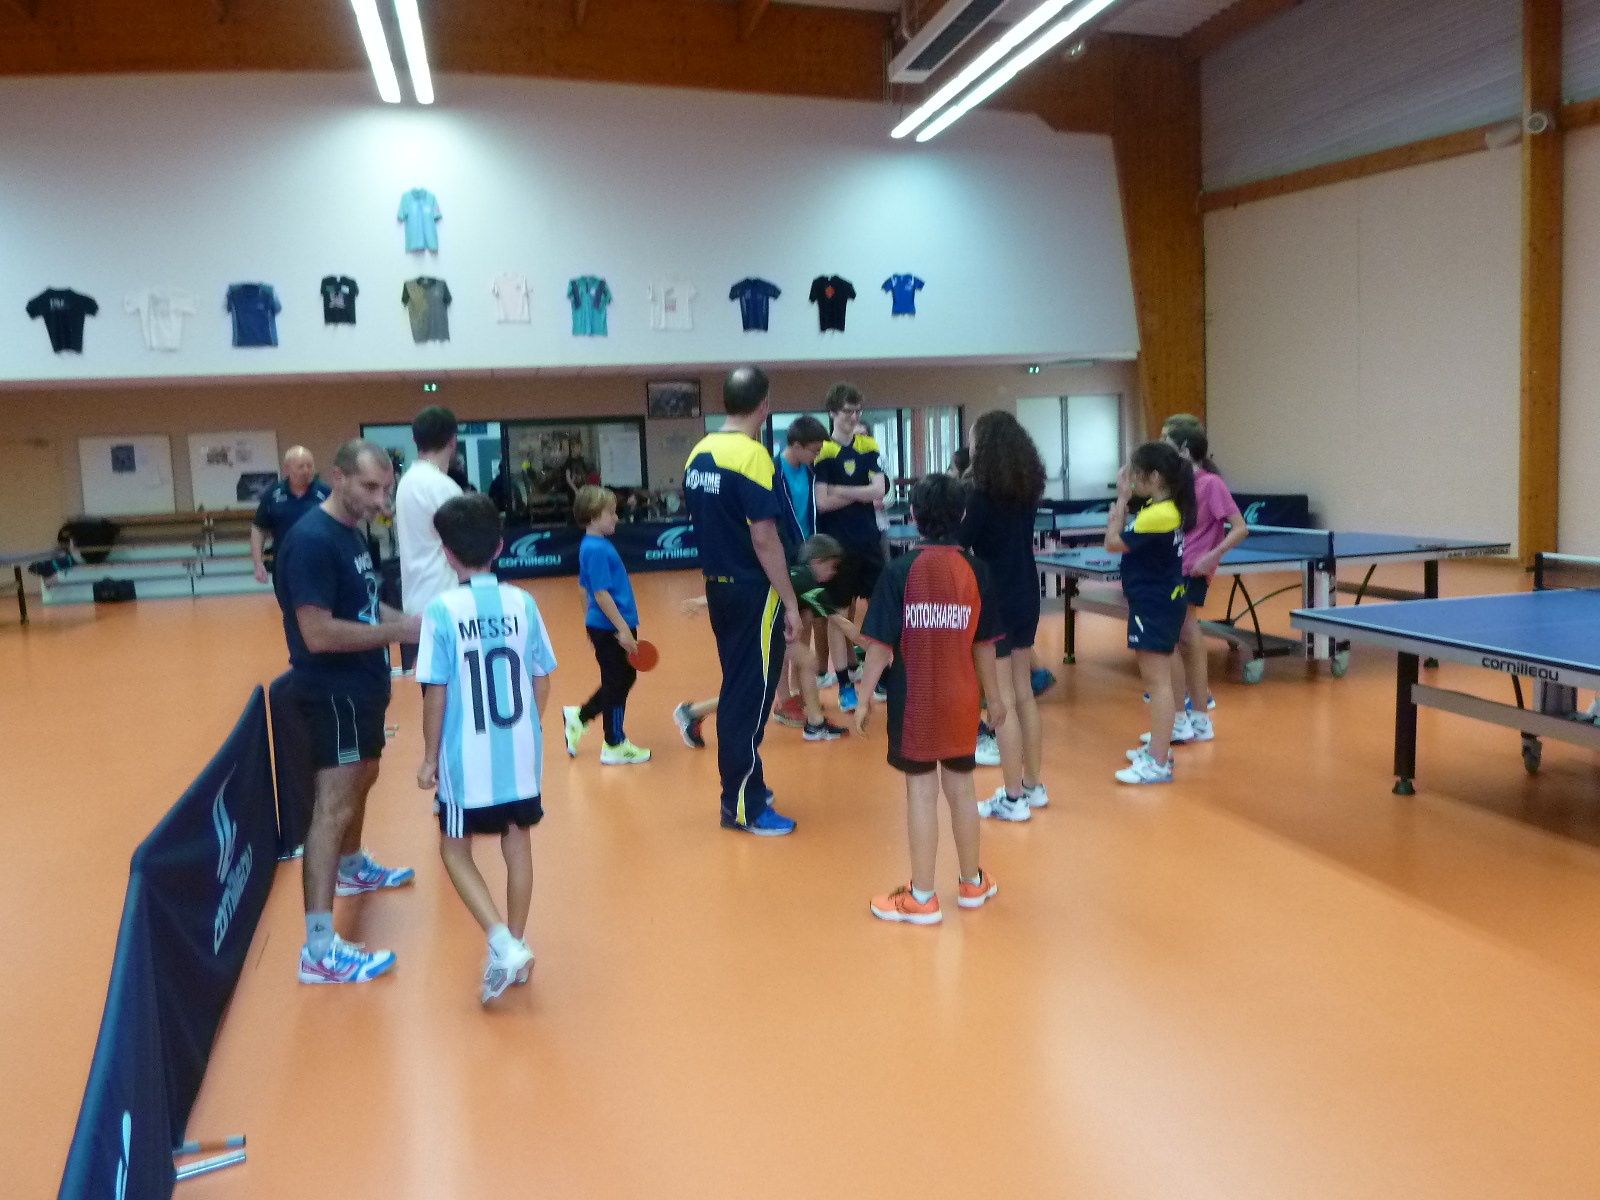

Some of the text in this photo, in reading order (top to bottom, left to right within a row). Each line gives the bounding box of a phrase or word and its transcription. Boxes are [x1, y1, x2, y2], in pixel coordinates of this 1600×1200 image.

[458, 614, 519, 641] MESSI
[1481, 656, 1559, 682] cornilleau
[463, 646, 524, 736] 10
